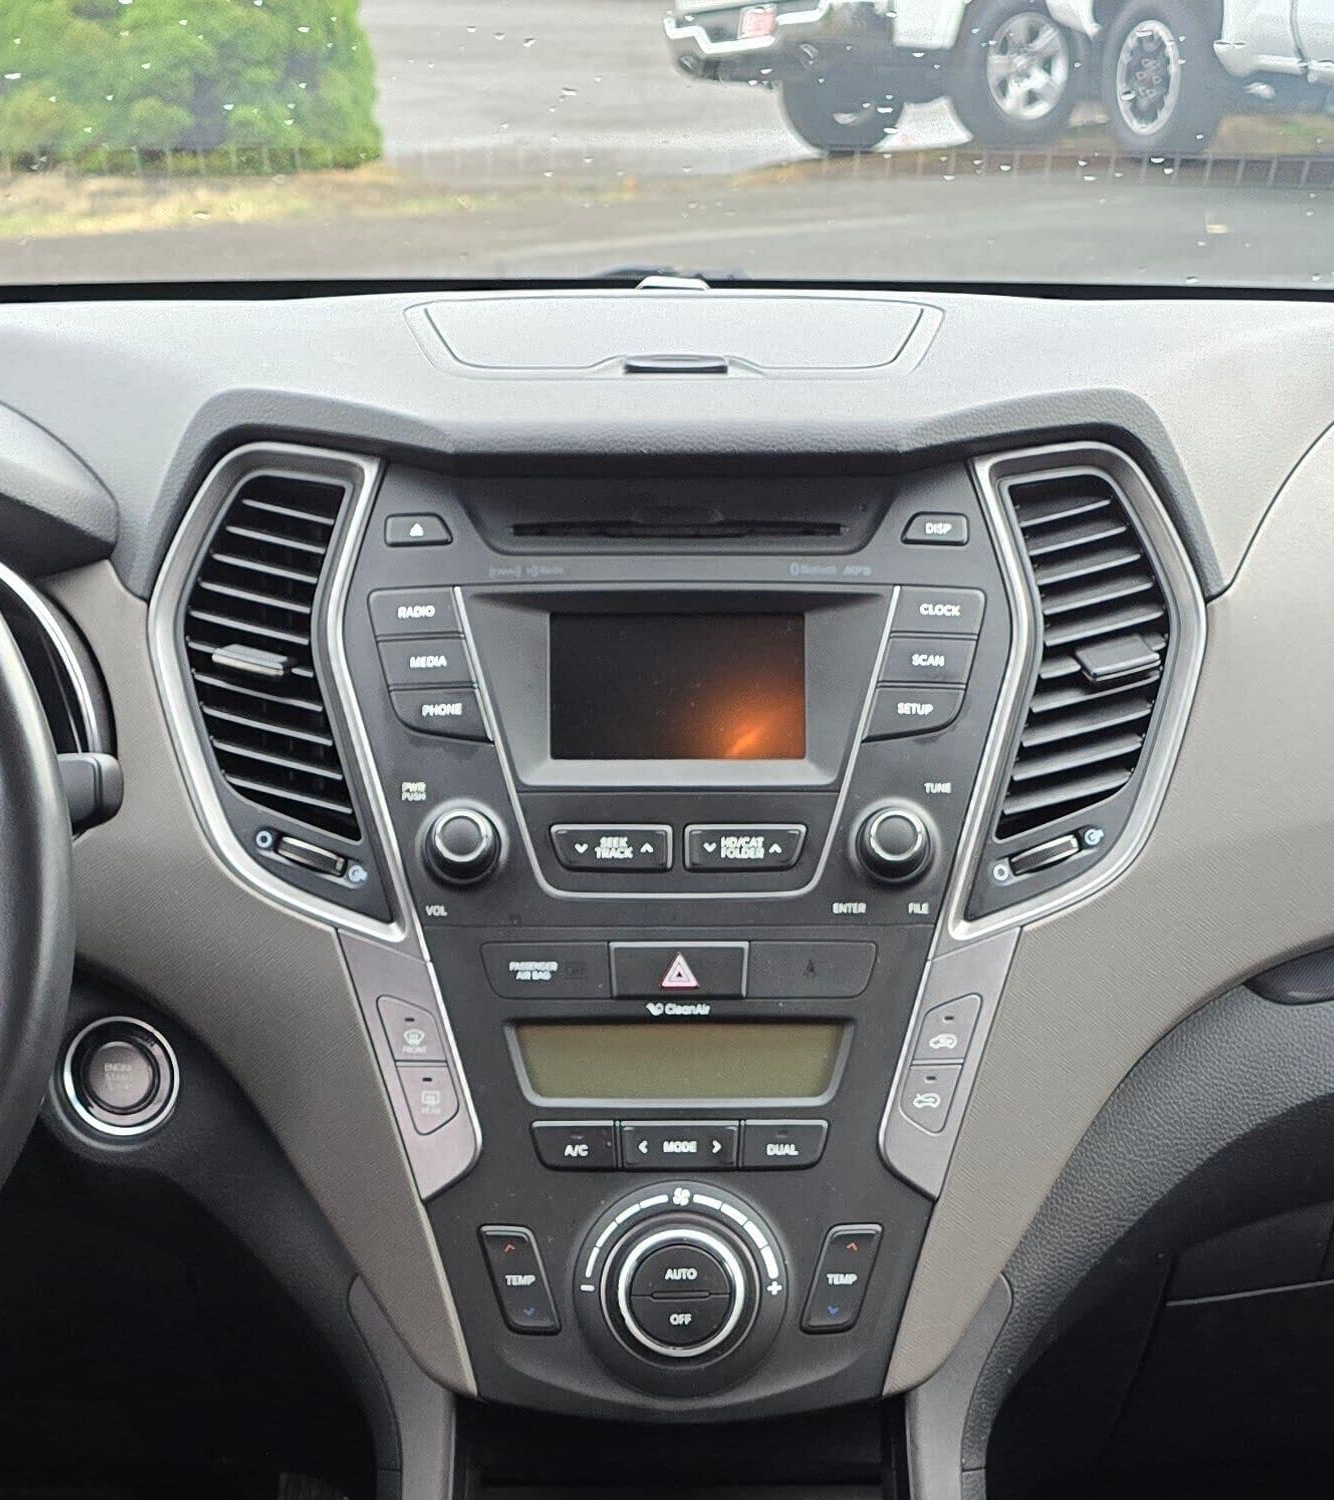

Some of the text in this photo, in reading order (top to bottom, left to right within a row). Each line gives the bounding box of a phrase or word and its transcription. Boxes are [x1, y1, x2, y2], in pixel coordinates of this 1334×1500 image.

[925, 522, 952, 535] DISP
[397, 605, 435, 619] RADIO
[919, 603, 961, 617] CLOCK
[409, 655, 447, 669] MEDIA
[911, 653, 945, 668] SCAN
[421, 703, 463, 717] PHONE
[897, 702, 934, 716] SETUP
[923, 782, 952, 794] TUNE
[599, 836, 629, 849] SEEK
[594, 847, 634, 859] TRACK
[720, 847, 765, 859] FOLDER
[425, 905, 448, 917] VOL
[832, 902, 867, 914] ENTER
[908, 902, 929, 915] FILE
[564, 1144, 589, 1157] A/C
[663, 1140, 698, 1153] MODE
[766, 1143, 799, 1156] DUAL
[505, 1274, 536, 1287] TEMP
[664, 1268, 698, 1281] AUTO
[826, 1273, 859, 1286] TEMP
[669, 1312, 693, 1326] OFF
